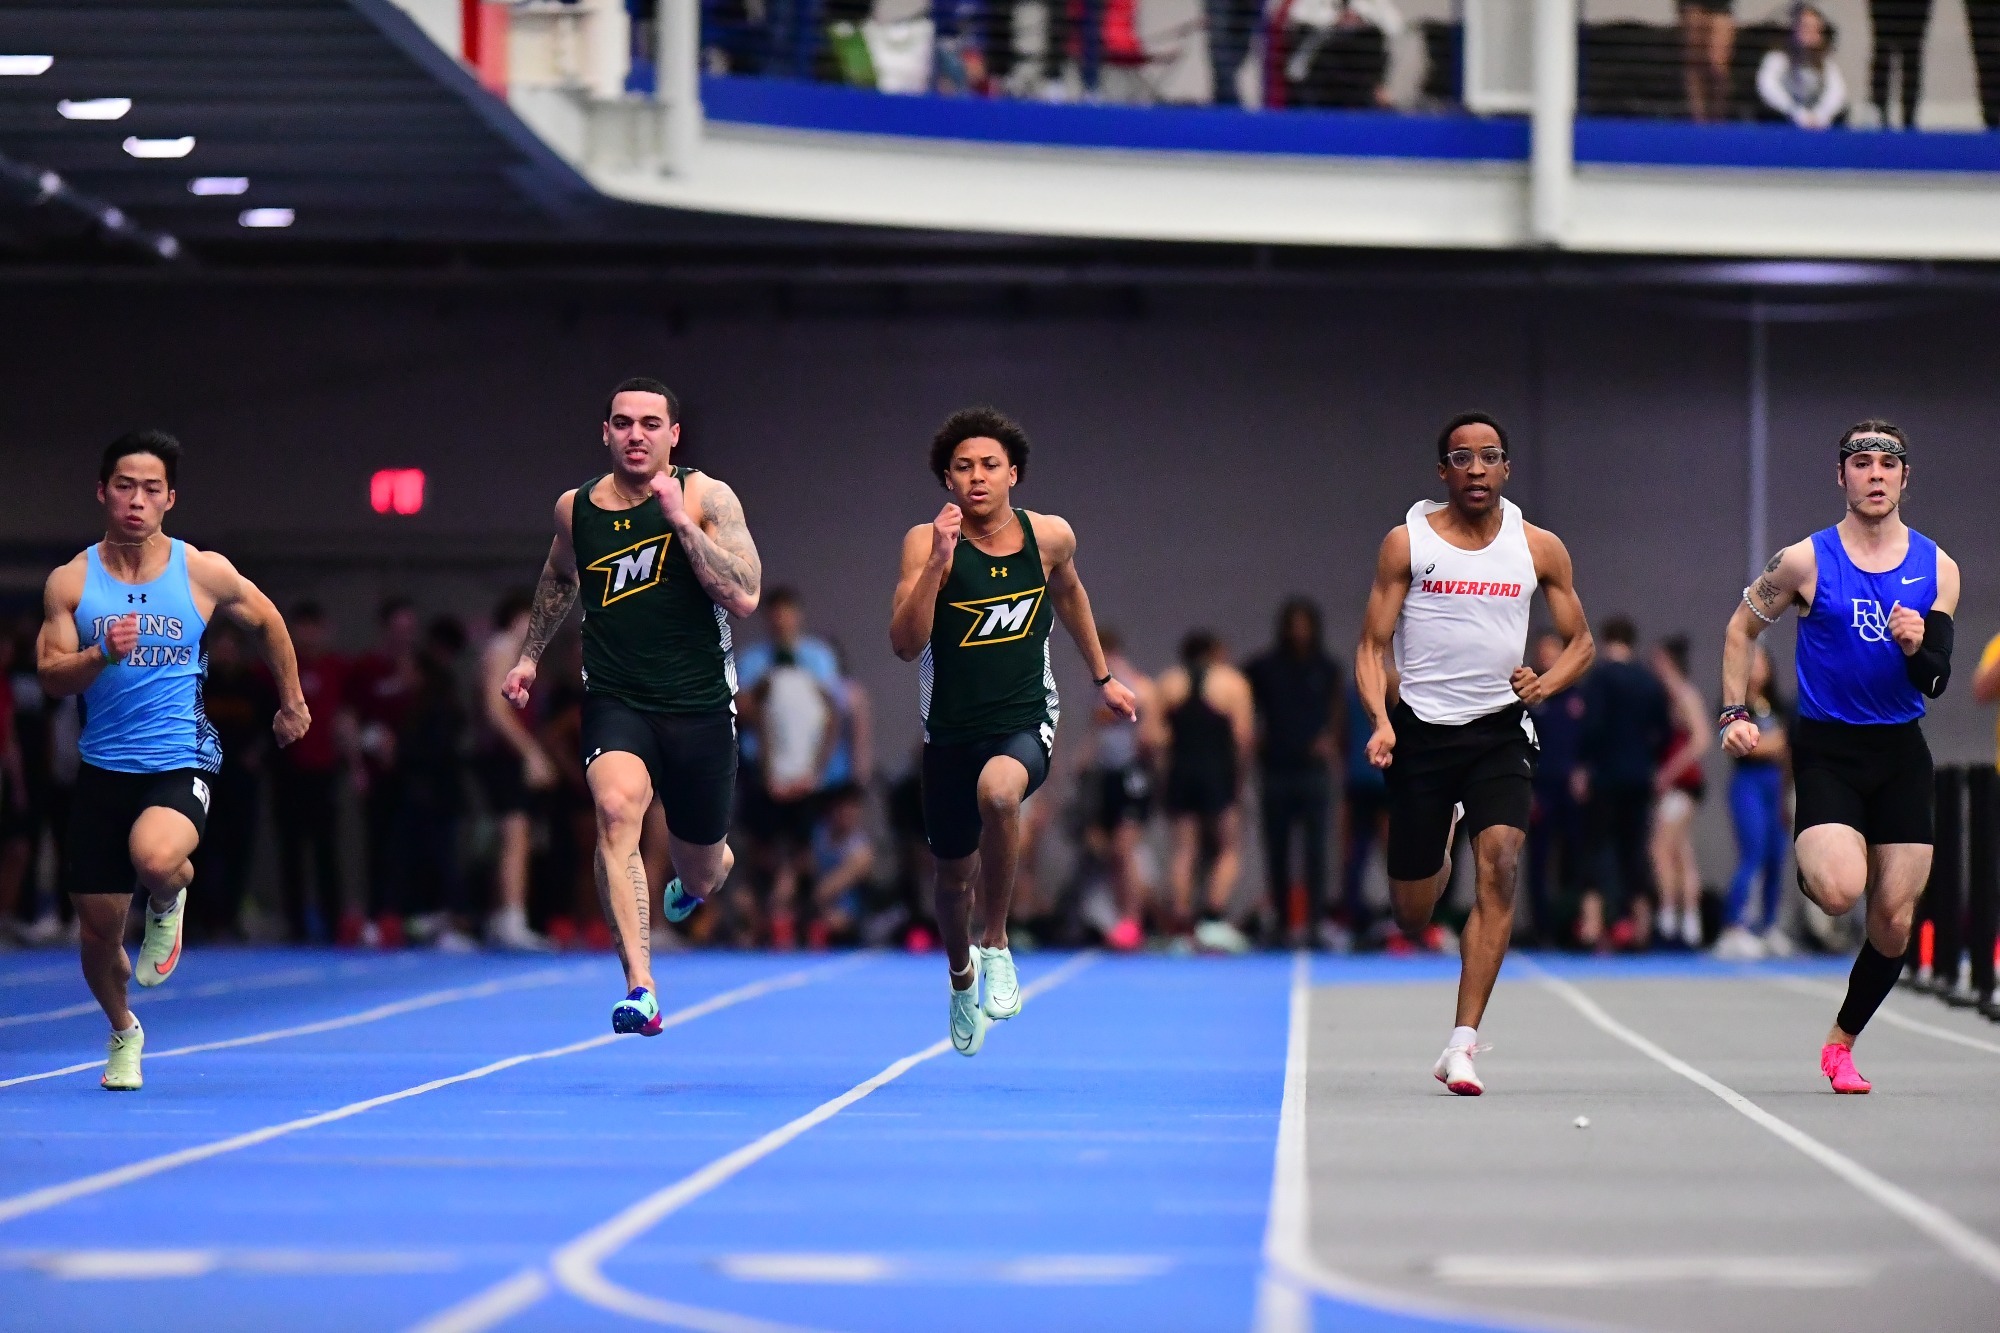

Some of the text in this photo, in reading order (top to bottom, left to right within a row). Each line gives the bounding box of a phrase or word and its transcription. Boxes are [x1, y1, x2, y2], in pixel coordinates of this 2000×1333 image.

[610, 545, 658, 593] M
[1421, 579, 1522, 598] HAVERFORD
[983, 597, 1035, 637] M
